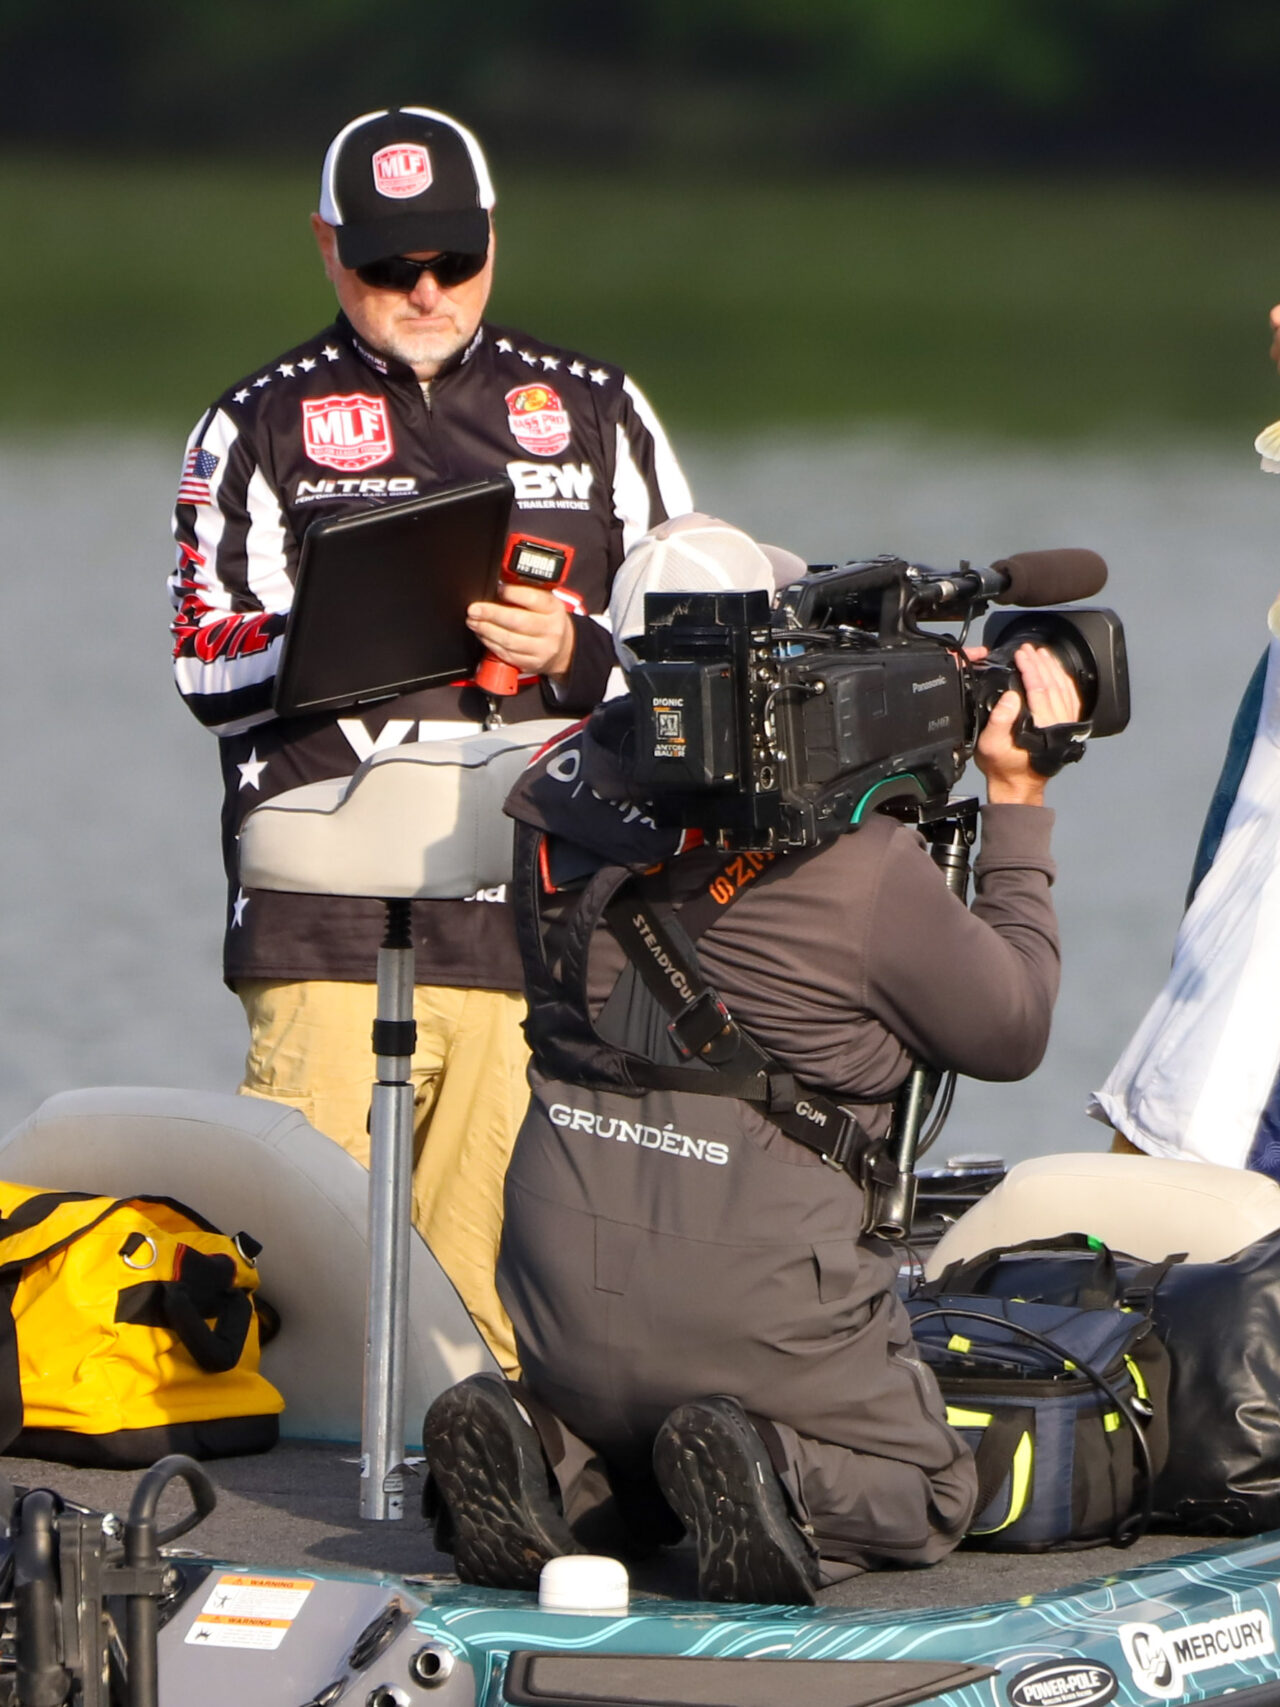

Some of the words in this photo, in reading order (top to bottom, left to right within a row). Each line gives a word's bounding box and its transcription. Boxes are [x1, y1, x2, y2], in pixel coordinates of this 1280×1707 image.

[380, 154, 423, 178] MLF
[310, 409, 380, 446] MLF
[297, 477, 417, 496] NITRO
[517, 500, 556, 510] TRAILER
[557, 500, 590, 511] HITCHES
[912, 674, 947, 694] Panasonic
[652, 697, 684, 707] DIONIC
[549, 1103, 730, 1166] GRUNDÉNS
[250, 1579, 295, 1589] WARNING
[228, 1617, 272, 1627] WARNING
[1172, 1620, 1265, 1664] MERCURY
[1022, 1670, 1102, 1703] POWER-POLE
